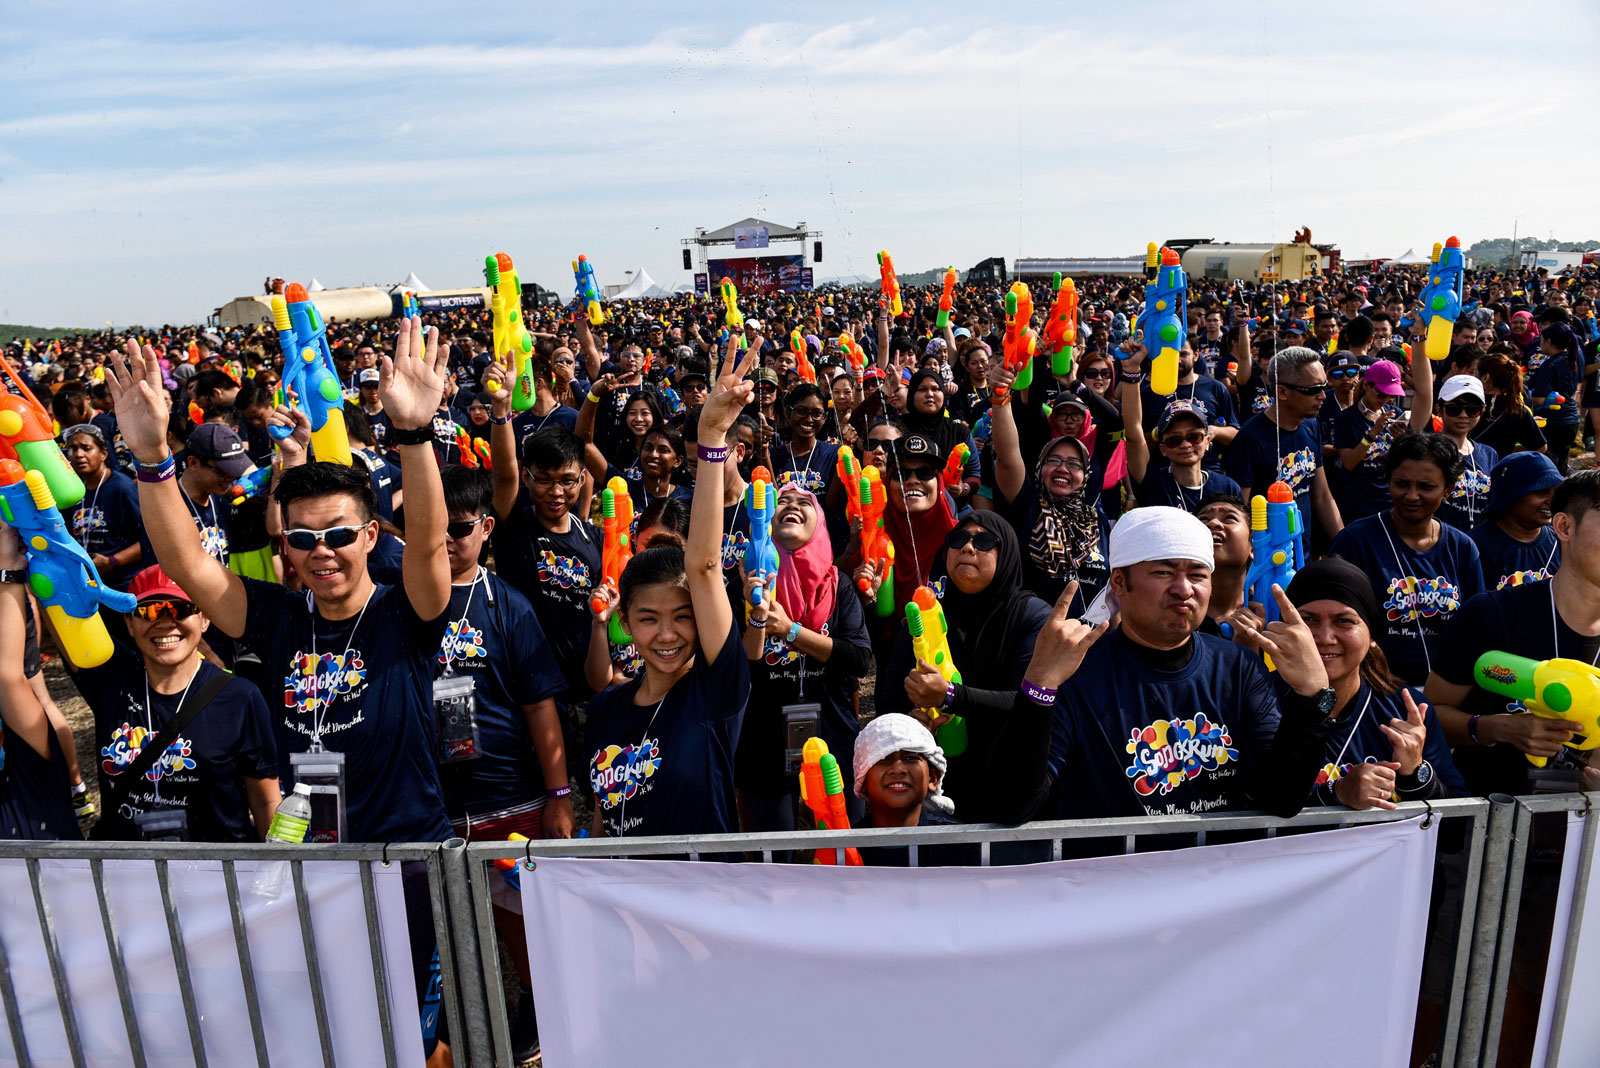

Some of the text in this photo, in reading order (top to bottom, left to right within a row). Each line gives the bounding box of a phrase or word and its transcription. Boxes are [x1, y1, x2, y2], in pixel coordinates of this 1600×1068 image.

[440, 296, 480, 307] BIOTHERM
[707, 451, 727, 459] OTER
[1028, 688, 1056, 702] OOTER
